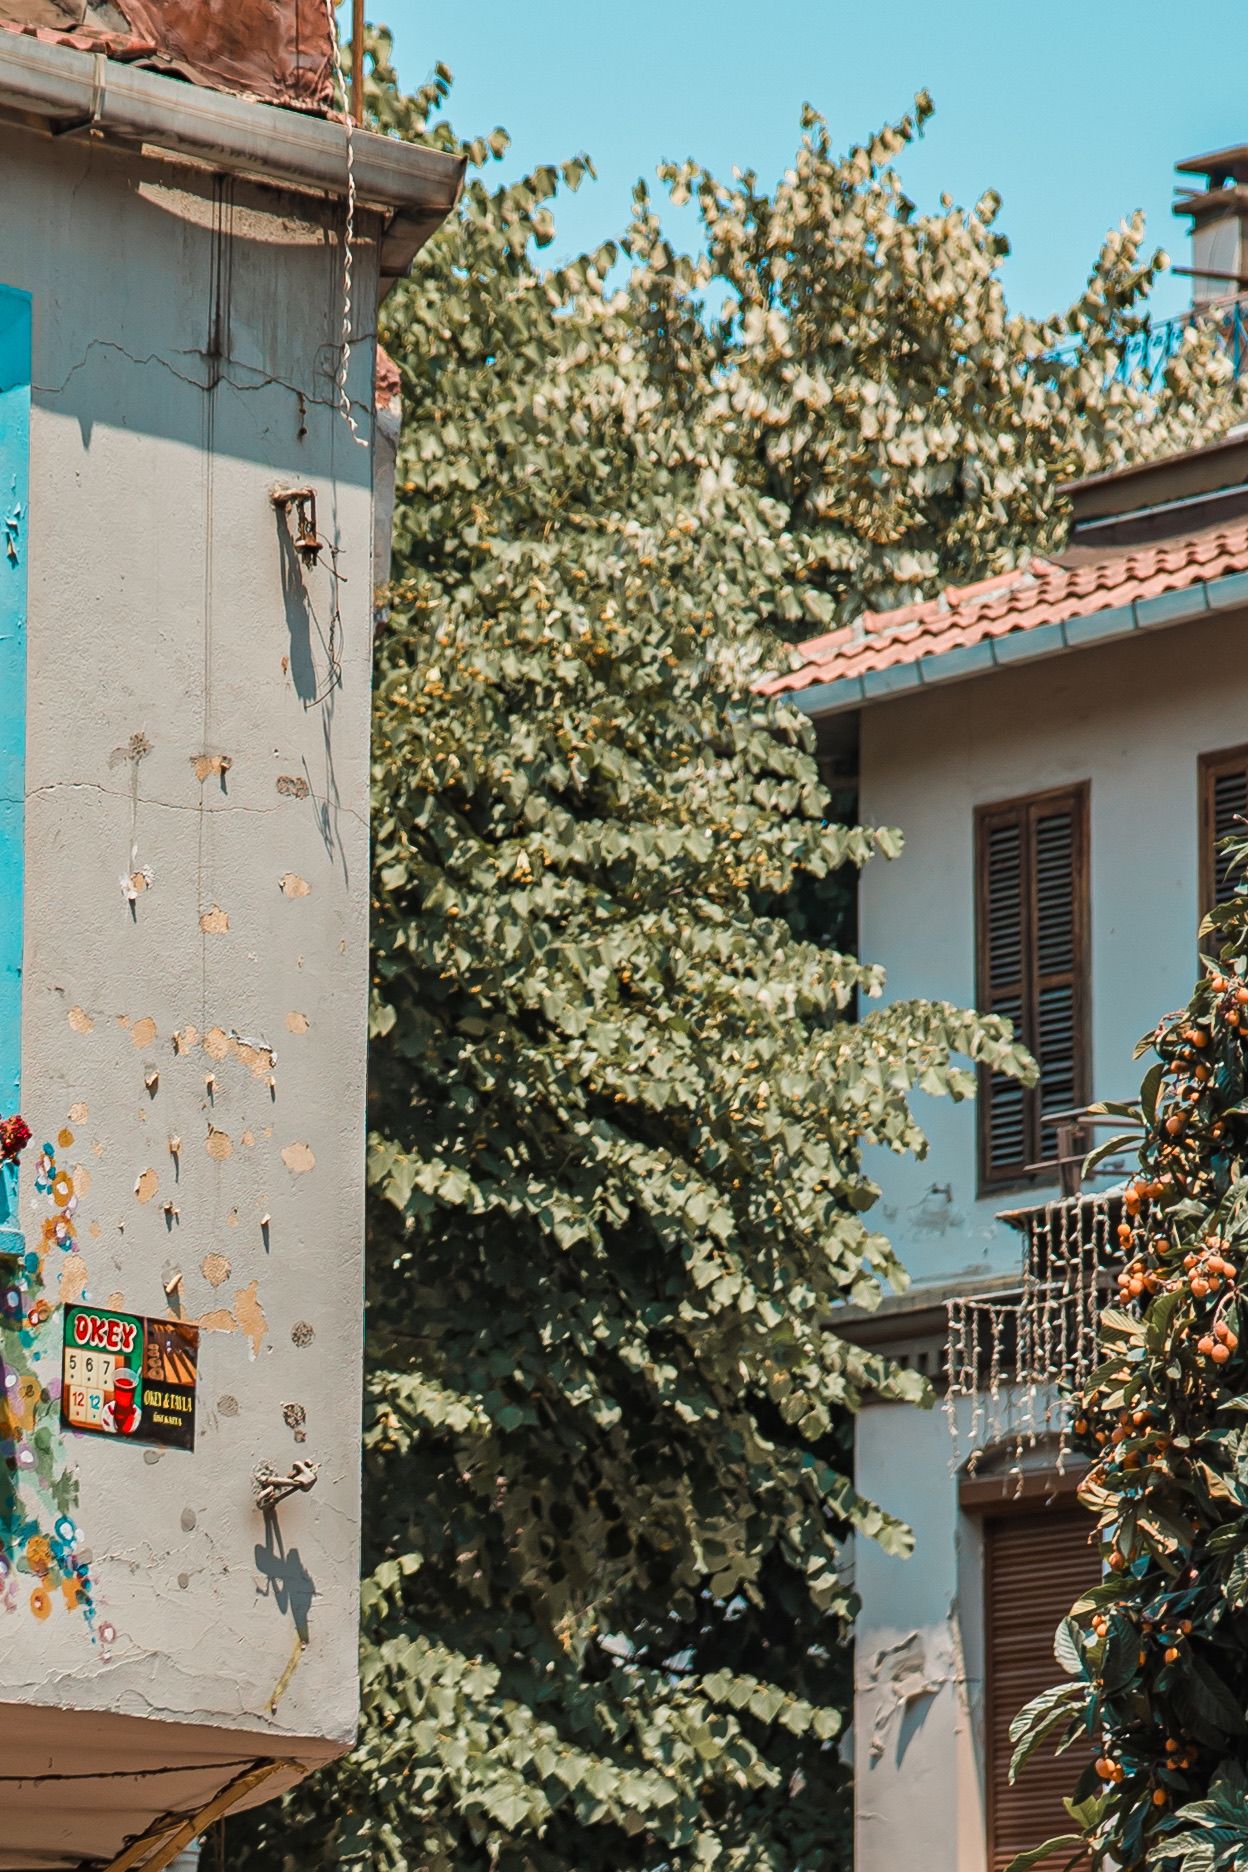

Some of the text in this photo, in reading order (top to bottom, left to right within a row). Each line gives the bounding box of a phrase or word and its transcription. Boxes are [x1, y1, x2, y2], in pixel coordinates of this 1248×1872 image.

[74, 1313, 137, 1352] OKEY
[69, 1355, 111, 1375] 5 6 7
[72, 1392, 101, 1409] 12 12
